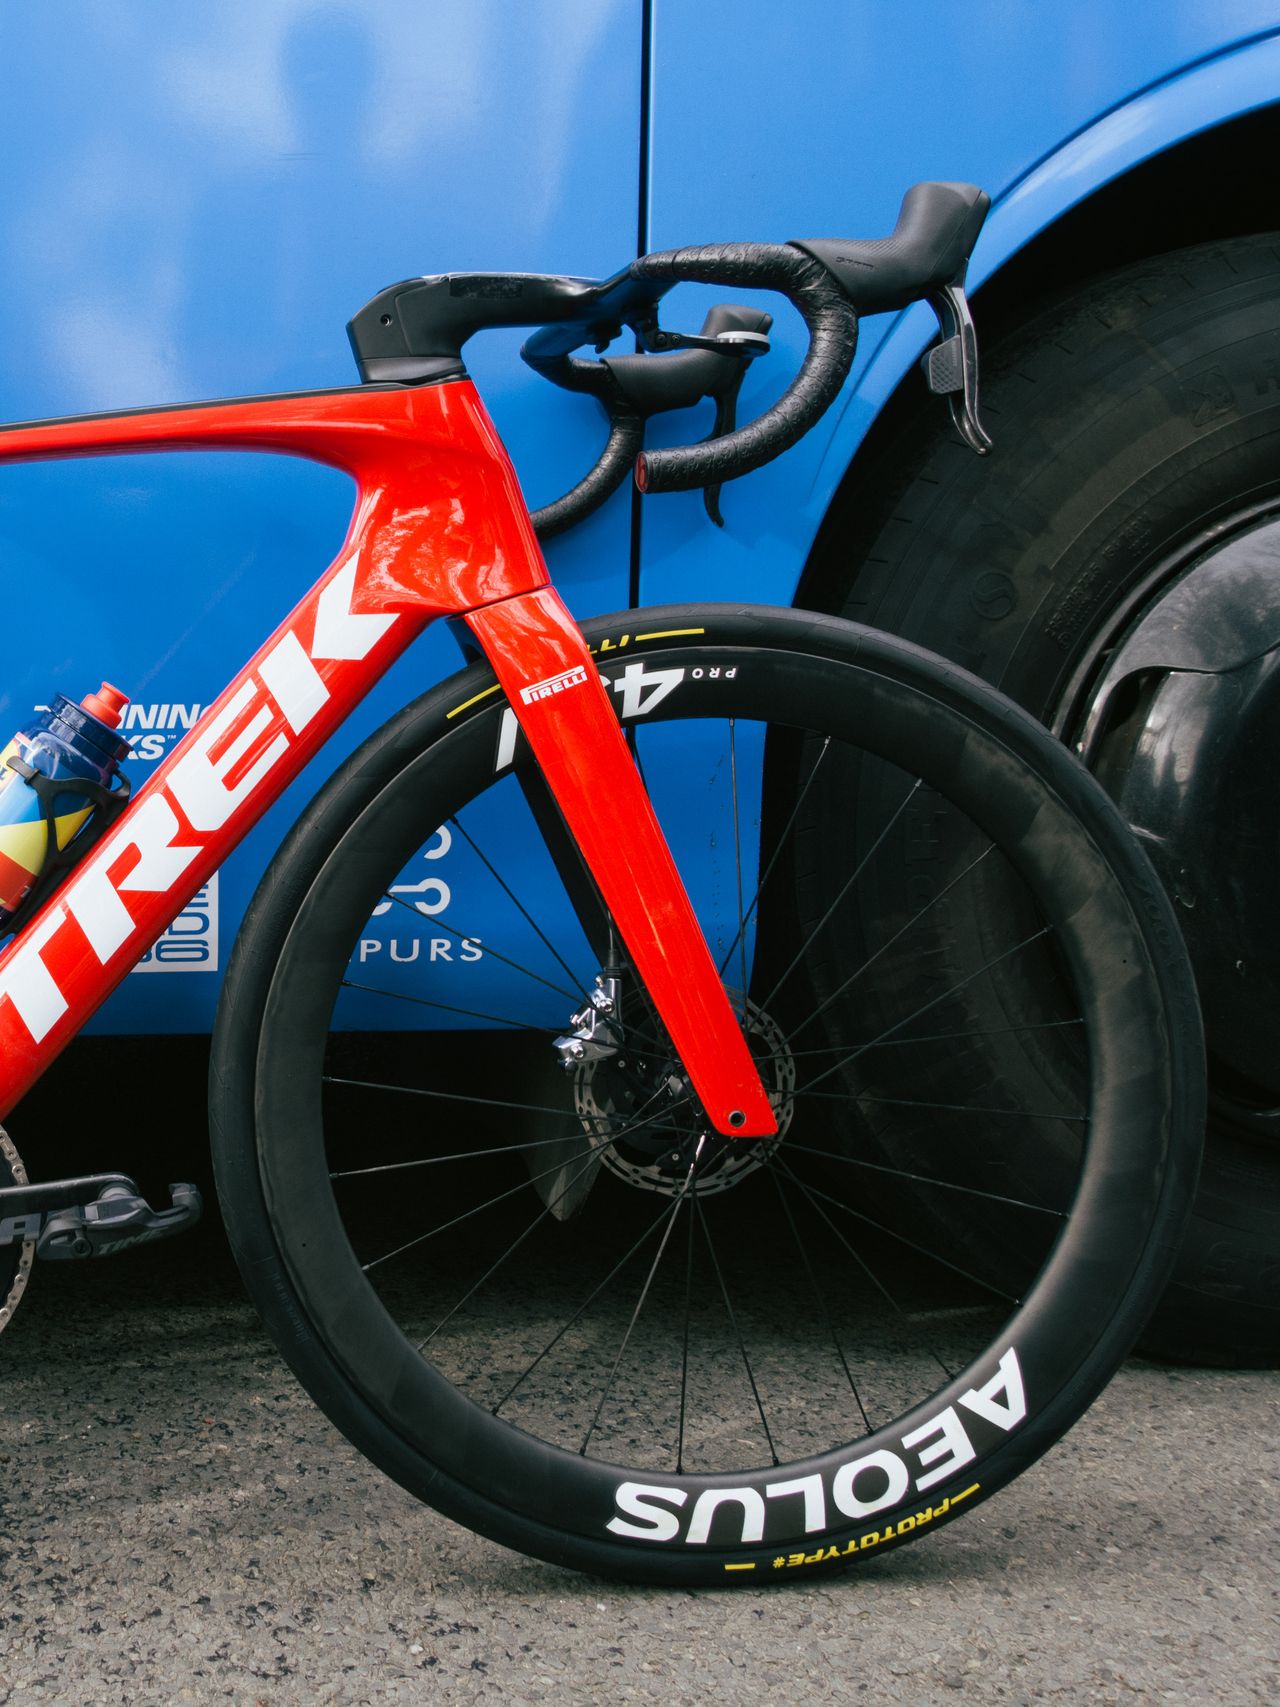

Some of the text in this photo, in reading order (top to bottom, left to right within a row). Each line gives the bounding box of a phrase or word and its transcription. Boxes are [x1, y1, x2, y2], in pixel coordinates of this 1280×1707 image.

[520, 665, 588, 705] PIRELLI
[692, 667, 738, 679] PRO
[606, 1346, 1027, 1544] AEOLUS
